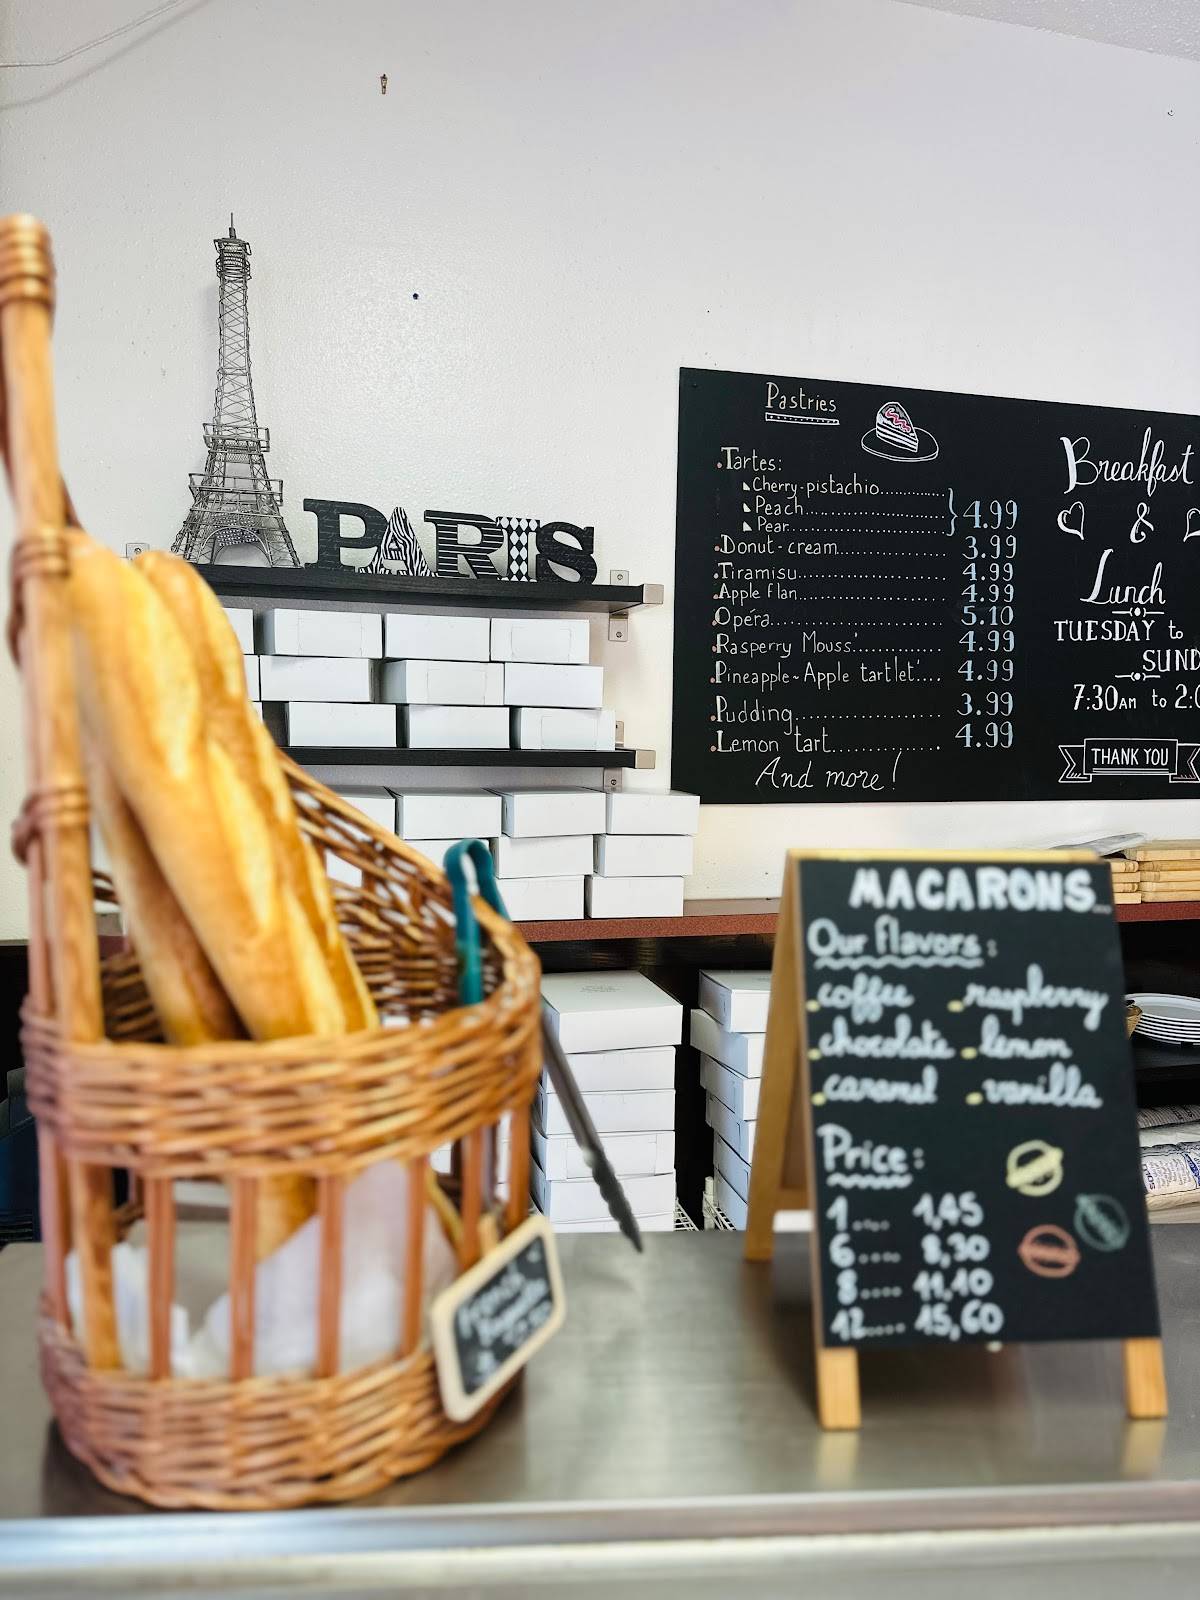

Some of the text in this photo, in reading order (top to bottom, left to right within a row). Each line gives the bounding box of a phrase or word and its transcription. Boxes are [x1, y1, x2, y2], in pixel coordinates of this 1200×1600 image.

[765, 382, 837, 413] Pastries
[721, 446, 783, 472] Tartes:
[1059, 427, 1195, 497] Breakfast
[755, 495, 1018, 530] Peach 4.99
[757, 517, 790, 534] Pear
[1130, 501, 1155, 543] &
[303, 498, 598, 585] PARIS
[962, 534, 1017, 560] 3.99
[717, 561, 1014, 582] Tiramisu 4.99
[1080, 548, 1166, 605] Lunch
[718, 582, 1015, 606] Apple flan 4.99
[714, 605, 1014, 633] Opéra 5.10
[1054, 619, 1184, 642] TUESDAY to
[716, 633, 792, 659] Rasperry
[958, 629, 1015, 652] 4.99
[958, 658, 1014, 682] 4.99
[1142, 648, 1200, 673] SUND
[716, 691, 1014, 735] Pudding 3.99
[1151, 688, 1167, 709] to
[716, 721, 1014, 753] Lemon tart 4.99
[1091, 746, 1169, 766] THANK YOU
[755, 756, 814, 789] And
[849, 867, 1096, 912] MACARONS
[807, 917, 868, 956] Our
[817, 971, 914, 1024] coffee
[818, 1013, 1073, 1059] chocolate lemon
[823, 1061, 1102, 1109] caramel vanilla
